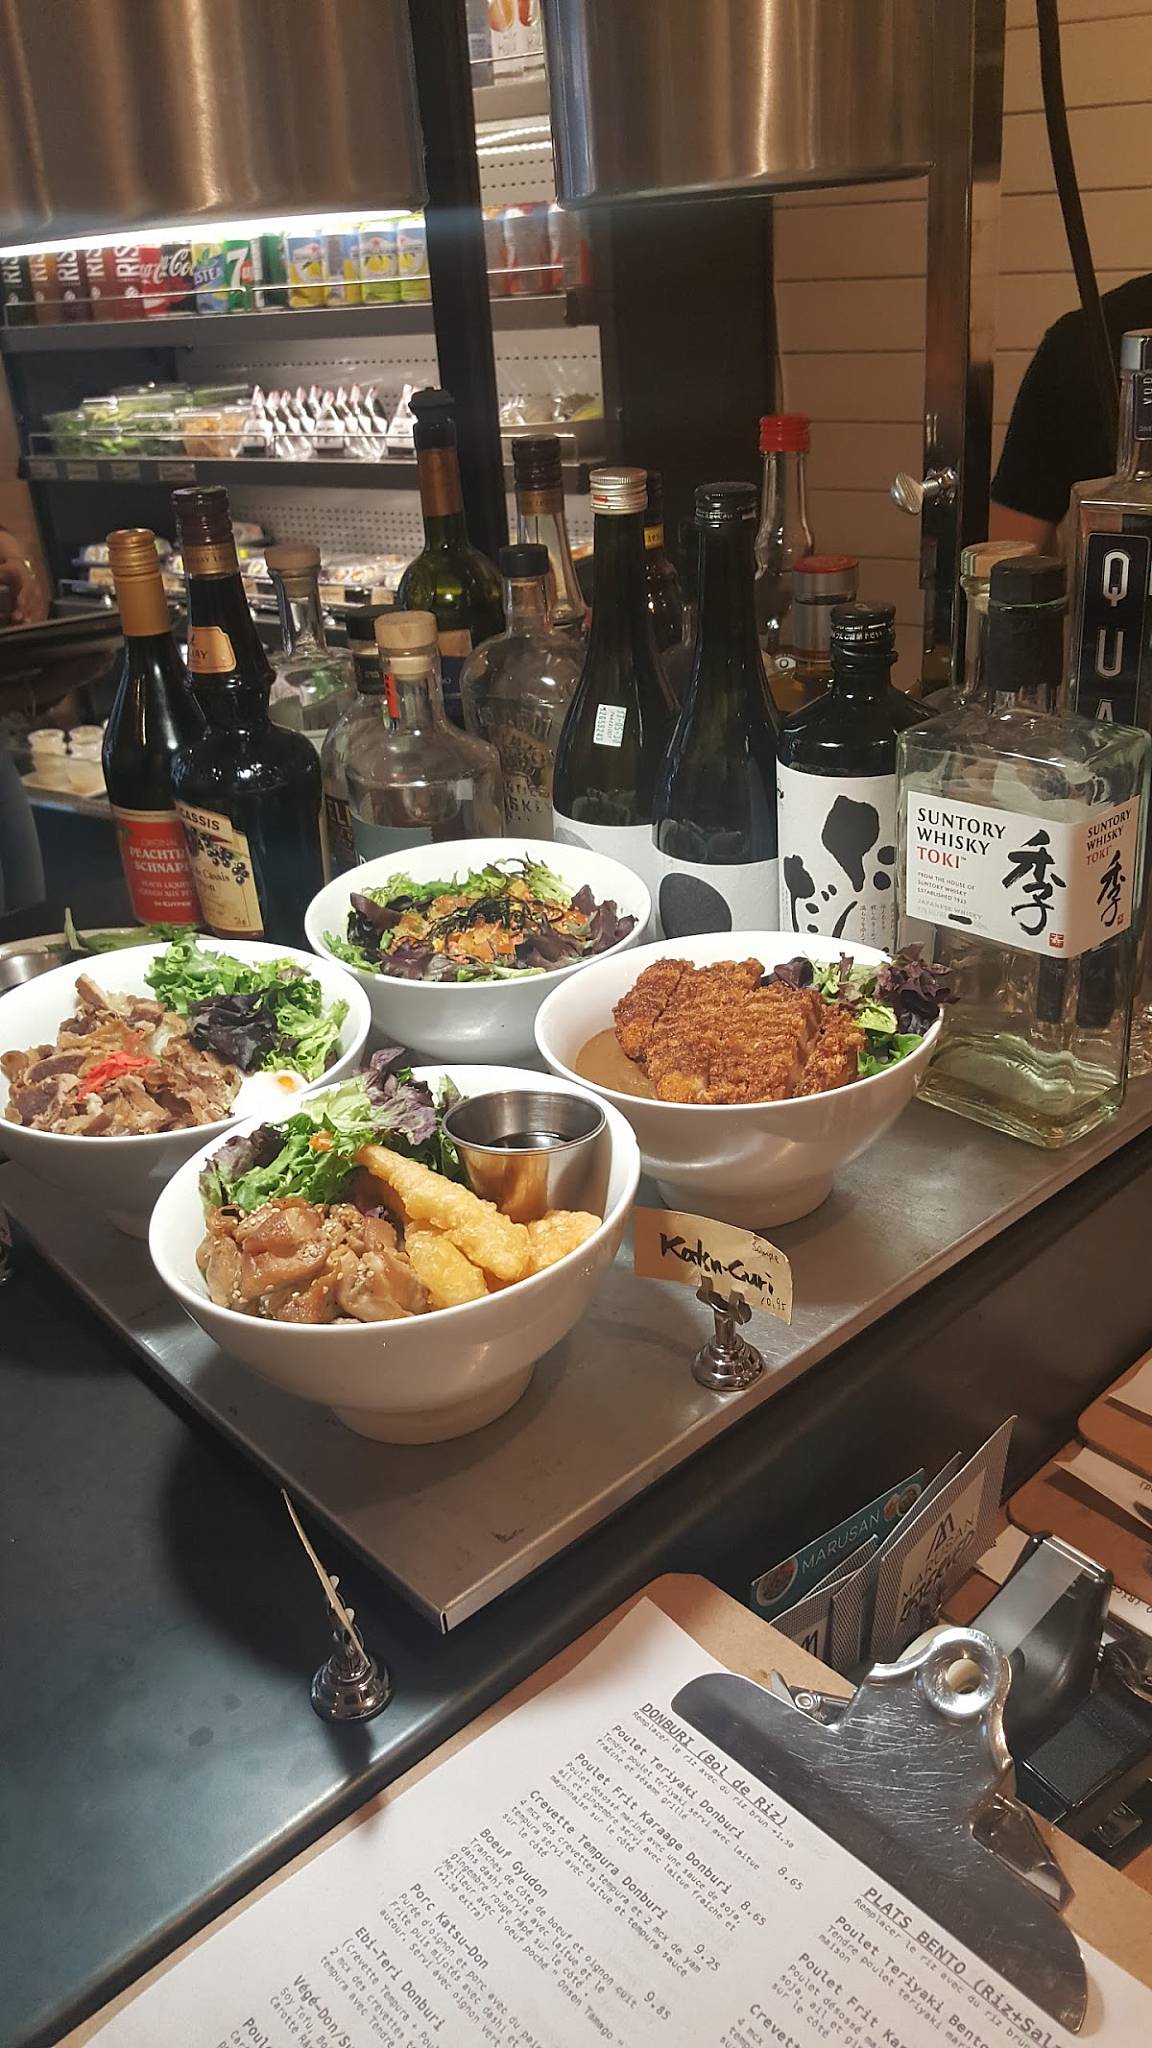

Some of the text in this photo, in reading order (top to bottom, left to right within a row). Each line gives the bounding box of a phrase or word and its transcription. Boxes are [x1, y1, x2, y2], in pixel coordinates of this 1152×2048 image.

[917, 807, 1007, 840] SUNTORY
[917, 826, 991, 856] WHISKY
[1087, 825, 1125, 851] WHISKY
[1088, 808, 1132, 839] SUNTORY
[1001, 829, 1067, 936] 季
[801, 1509, 882, 1576] MARUSAN
[602, 1732, 628, 1754] Tendre
[626, 1754, 654, 1778] poulet
[652, 1777, 688, 1808] teriyaki
[688, 1807, 712, 1828] servi
[711, 1828, 731, 1845] avec
[611, 1724, 744, 1839] Poulet Teriyaki Donburi
[624, 1763, 635, 1773] et
[641, 1702, 789, 1828] DONBURI (Bol de Riz)
[670, 1743, 682, 1753] le
[682, 1753, 698, 1766] riz
[698, 1767, 717, 1783] avec
[731, 1794, 747, 1808] riz
[516, 1827, 529, 1839] le
[527, 1838, 549, 1858] côté
[529, 1789, 668, 1920] Crevette Tempura Donburi
[557, 1767, 573, 1780] ail
[572, 1780, 584, 1790] et
[620, 1824, 644, 1846] servi
[643, 1846, 662, 1864] avec
[724, 1919, 737, 1932] et
[565, 1761, 591, 1784] Poulet
[646, 1836, 665, 1853] avec
[666, 1854, 681, 1868] une
[682, 1868, 705, 1890] sauce
[706, 1889, 719, 1901] de
[574, 1752, 732, 1894] Poulet Frit Karaage Donburi
[604, 1824, 616, 1835] le
[615, 1834, 636, 1853] côté
[478, 1828, 550, 1899] Boeuf Gyudon
[509, 1805, 542, 1835] tempura
[540, 1834, 565, 1857] servi
[564, 1858, 584, 1877] avec
[614, 1904, 627, 1917] et
[625, 1917, 662, 1952] tempura
[661, 1951, 687, 1977] sauce
[542, 1820, 558, 1835] des
[557, 1835, 598, 1873] crevettes
[597, 1873, 631, 1906] tempura
[631, 1905, 644, 1918] et
[644, 1918, 653, 1926] 2
[670, 1943, 684, 1956] de
[683, 1957, 701, 1974] yam
[776, 1865, 805, 1891] 8.65
[408, 1883, 491, 1970] Porc Katsu-Don
[457, 1893, 485, 1922] extra)
[468, 1838, 504, 1873] Tranches
[503, 1872, 516, 1884] de
[535, 1905, 548, 1917] de
[547, 1917, 573, 1942] boeuf
[572, 1942, 585, 1955] et
[584, 1955, 616, 1987] oignon
[615, 1986, 638, 2009] cuit
[738, 1899, 768, 1927] 8.65
[864, 1886, 913, 1929] PLATS
[916, 1929, 968, 1975] BENTO
[353, 1926, 446, 2032] Ebi-Teri Donburi
[692, 1943, 723, 1972] 9.25
[817, 1933, 851, 1964] maison
[835, 1915, 881, 1956] Poulet
[881, 1956, 945, 2014] Teriyaki
[642, 1990, 673, 2021] 9.85
[790, 2000, 805, 2015] le
[805, 2014, 831, 2039] côté
[797, 1952, 844, 1995] Poulet
[844, 1994, 879, 2027] Frit
[241, 2017, 273, 2048] Poul
